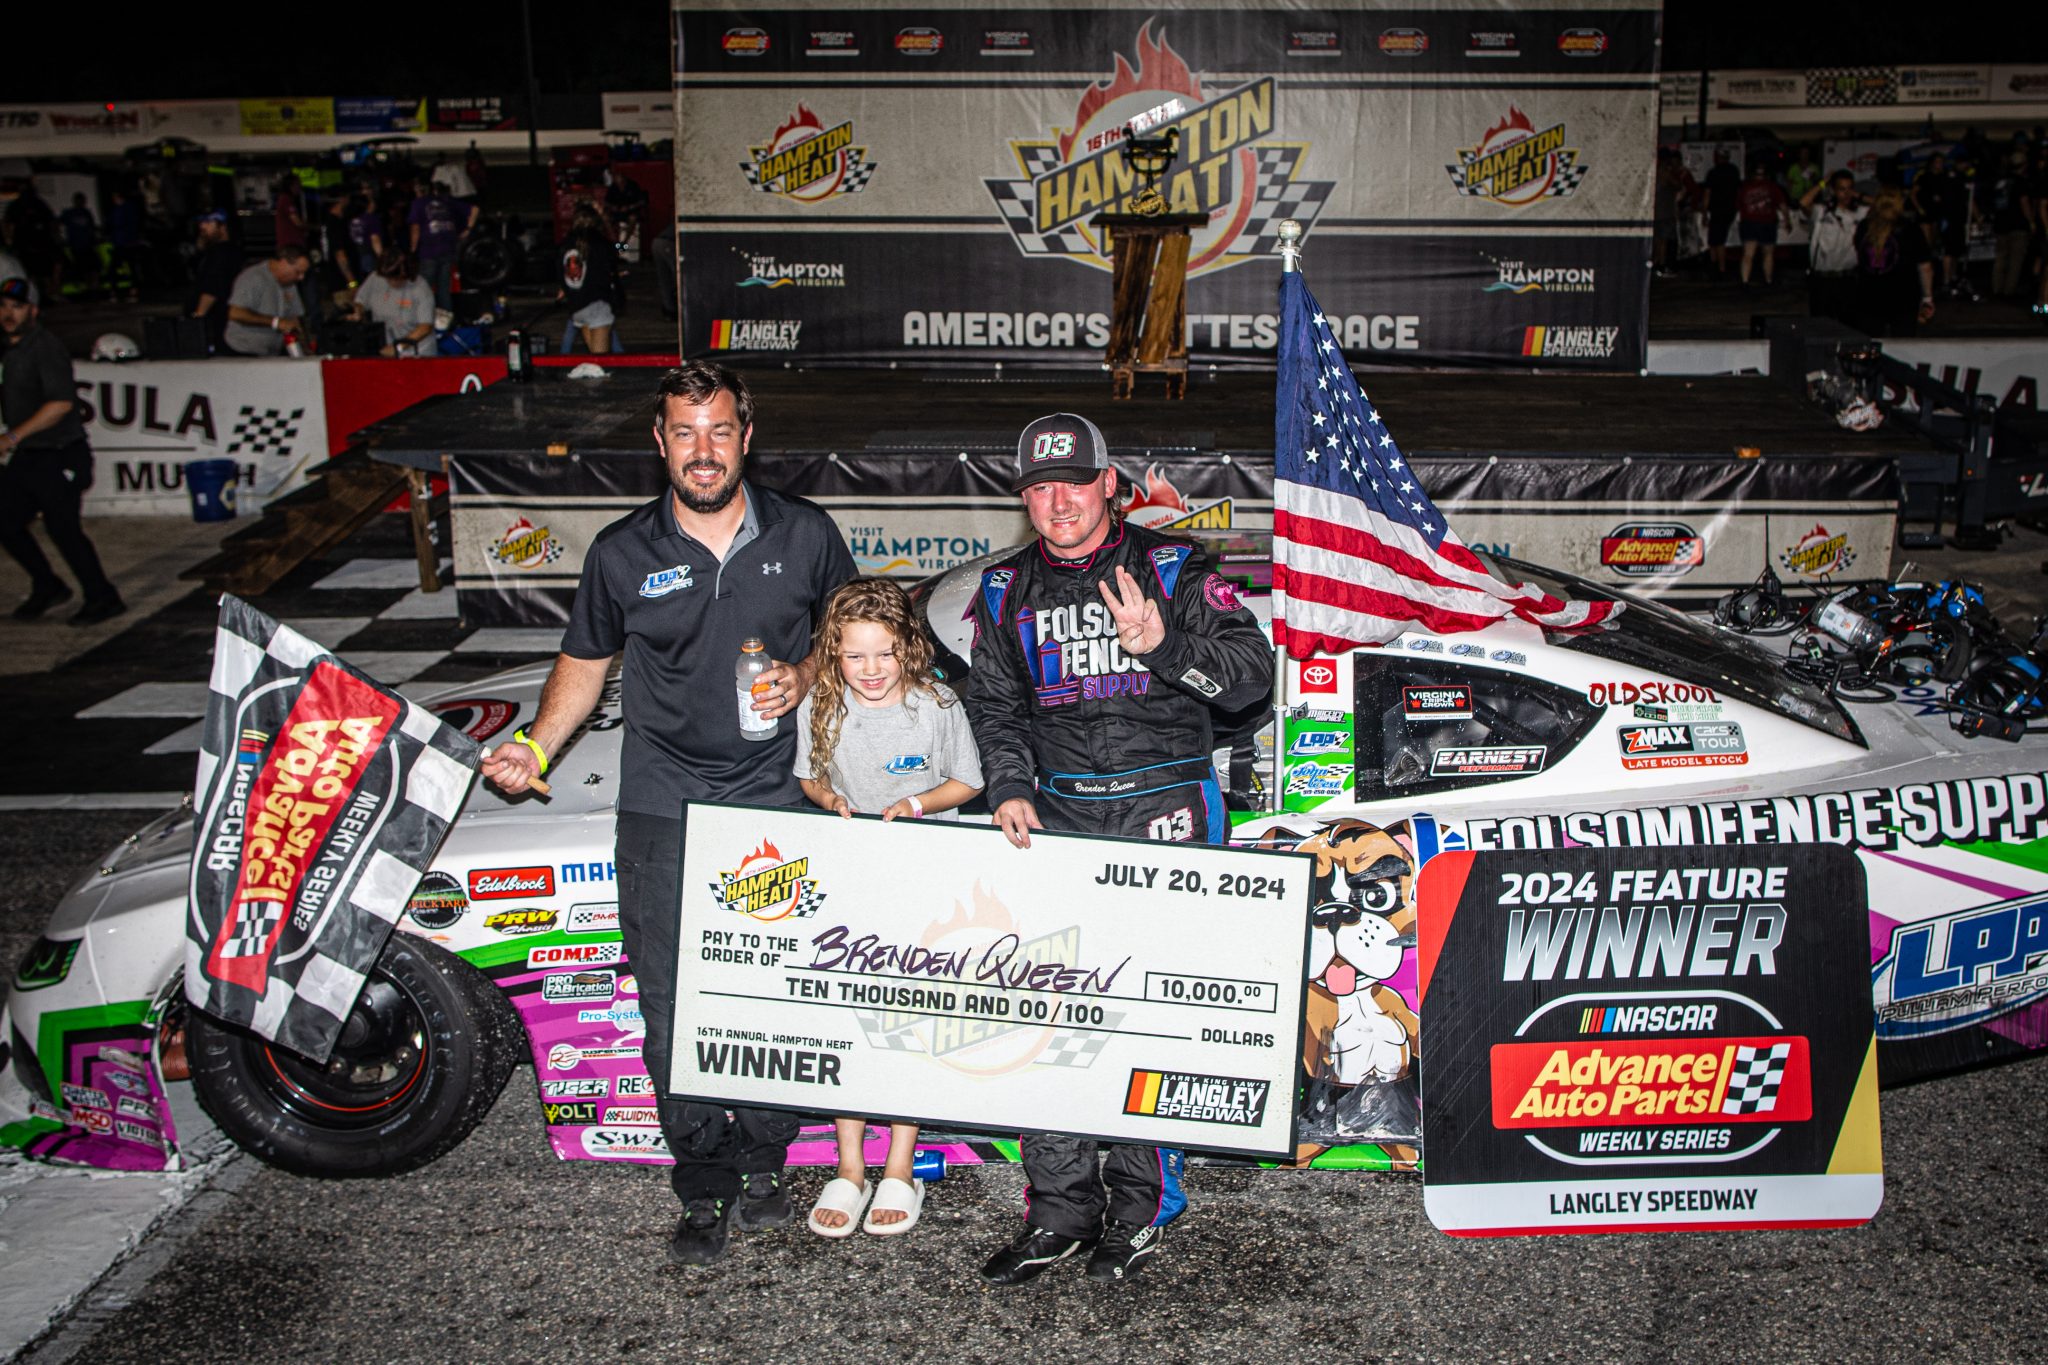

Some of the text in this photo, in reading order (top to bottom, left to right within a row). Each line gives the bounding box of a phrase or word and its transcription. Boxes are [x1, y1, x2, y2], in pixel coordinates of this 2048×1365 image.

[760, 123, 851, 184] HAMPTON
[1467, 126, 1564, 186] HAMPTON
[786, 153, 836, 191] HEAT
[1494, 156, 1544, 197] HEAT
[752, 264, 844, 278] HAMPTON
[1500, 268, 1595, 283] HAMPTON
[796, 279, 845, 287] VIRGINIA
[1544, 283, 1595, 292] VIRGINIA
[732, 324, 801, 340] LANGLEY
[903, 311, 1110, 347] AMERICA'S
[1186, 314, 1282, 348] TTES
[1545, 330, 1619, 347] LANGLEY
[730, 340, 799, 350] SPEEDWAY
[1543, 347, 1615, 357] SPEEDWAY
[1032, 433, 1073, 459] 03
[851, 527, 883, 536] VISIT
[1642, 528, 1676, 537] NASCAR
[851, 538, 990, 556] HAMPTON
[1616, 541, 1674, 553] Advance
[1608, 551, 1670, 562] Auto Parts
[1083, 673, 1151, 700] SUPPLY
[1410, 691, 1465, 700] VIRGINIA
[1589, 682, 1722, 706] OLDSKOOL
[1299, 733, 1336, 748] LPP
[1698, 738, 1740, 748] TOUR
[1437, 750, 1541, 767] EARNEST
[1628, 756, 1743, 769] LATE MODEL STOCK
[1458, 764, 1523, 773] PERFORMANCE
[1074, 780, 1136, 793] Brenden Queen
[1467, 805, 1696, 850] FOLSOM
[1706, 788, 1891, 848] FENCE
[475, 875, 546, 893] Edelbrock
[726, 858, 808, 904] HAMPTON
[1095, 863, 1286, 900] JULY 20, 2024
[1498, 867, 1789, 905] 2024 FEATURE
[747, 881, 792, 912] HEAT
[484, 909, 560, 926] PRW
[501, 924, 552, 935] Chassis
[702, 930, 799, 952] PAY TO THE
[1502, 903, 1788, 982] WINNER
[532, 947, 599, 963] COMP
[579, 955, 611, 963] CAMS
[701, 947, 781, 967] ORDER OF
[809, 925, 1132, 993] BRENDEN QUEEN
[1892, 902, 2048, 1001] LPP
[546, 983, 613, 995] FABrication
[547, 975, 573, 985] PRO
[785, 976, 1104, 1025] TEN THOUSAND AND 00/100
[1878, 989, 1972, 1024] PULLIAM
[580, 1010, 642, 1022] Pro-Syste
[1612, 1004, 1719, 1033] NASCAR
[697, 1026, 854, 1051] 16TH ANNUAL HAMPTON HEAT
[1201, 1027, 1275, 1049] DOLLARS
[696, 1040, 842, 1087] WINNER
[1532, 1048, 1718, 1087] Advance
[541, 1080, 609, 1097] TIGER
[1163, 1073, 1266, 1090] LARRY KING LAW'S
[1158, 1079, 1266, 1112] LANGLEY
[1510, 1083, 1710, 1119] Auto Parts
[75, 1111, 110, 1128] MSD
[616, 1110, 659, 1121] FLUIDYN
[1156, 1102, 1260, 1125] SPEEDWAY
[1578, 1129, 1731, 1153] WEEKLY SERIES
[1550, 1188, 1758, 1215] LANGLEY SPEEDWAY
